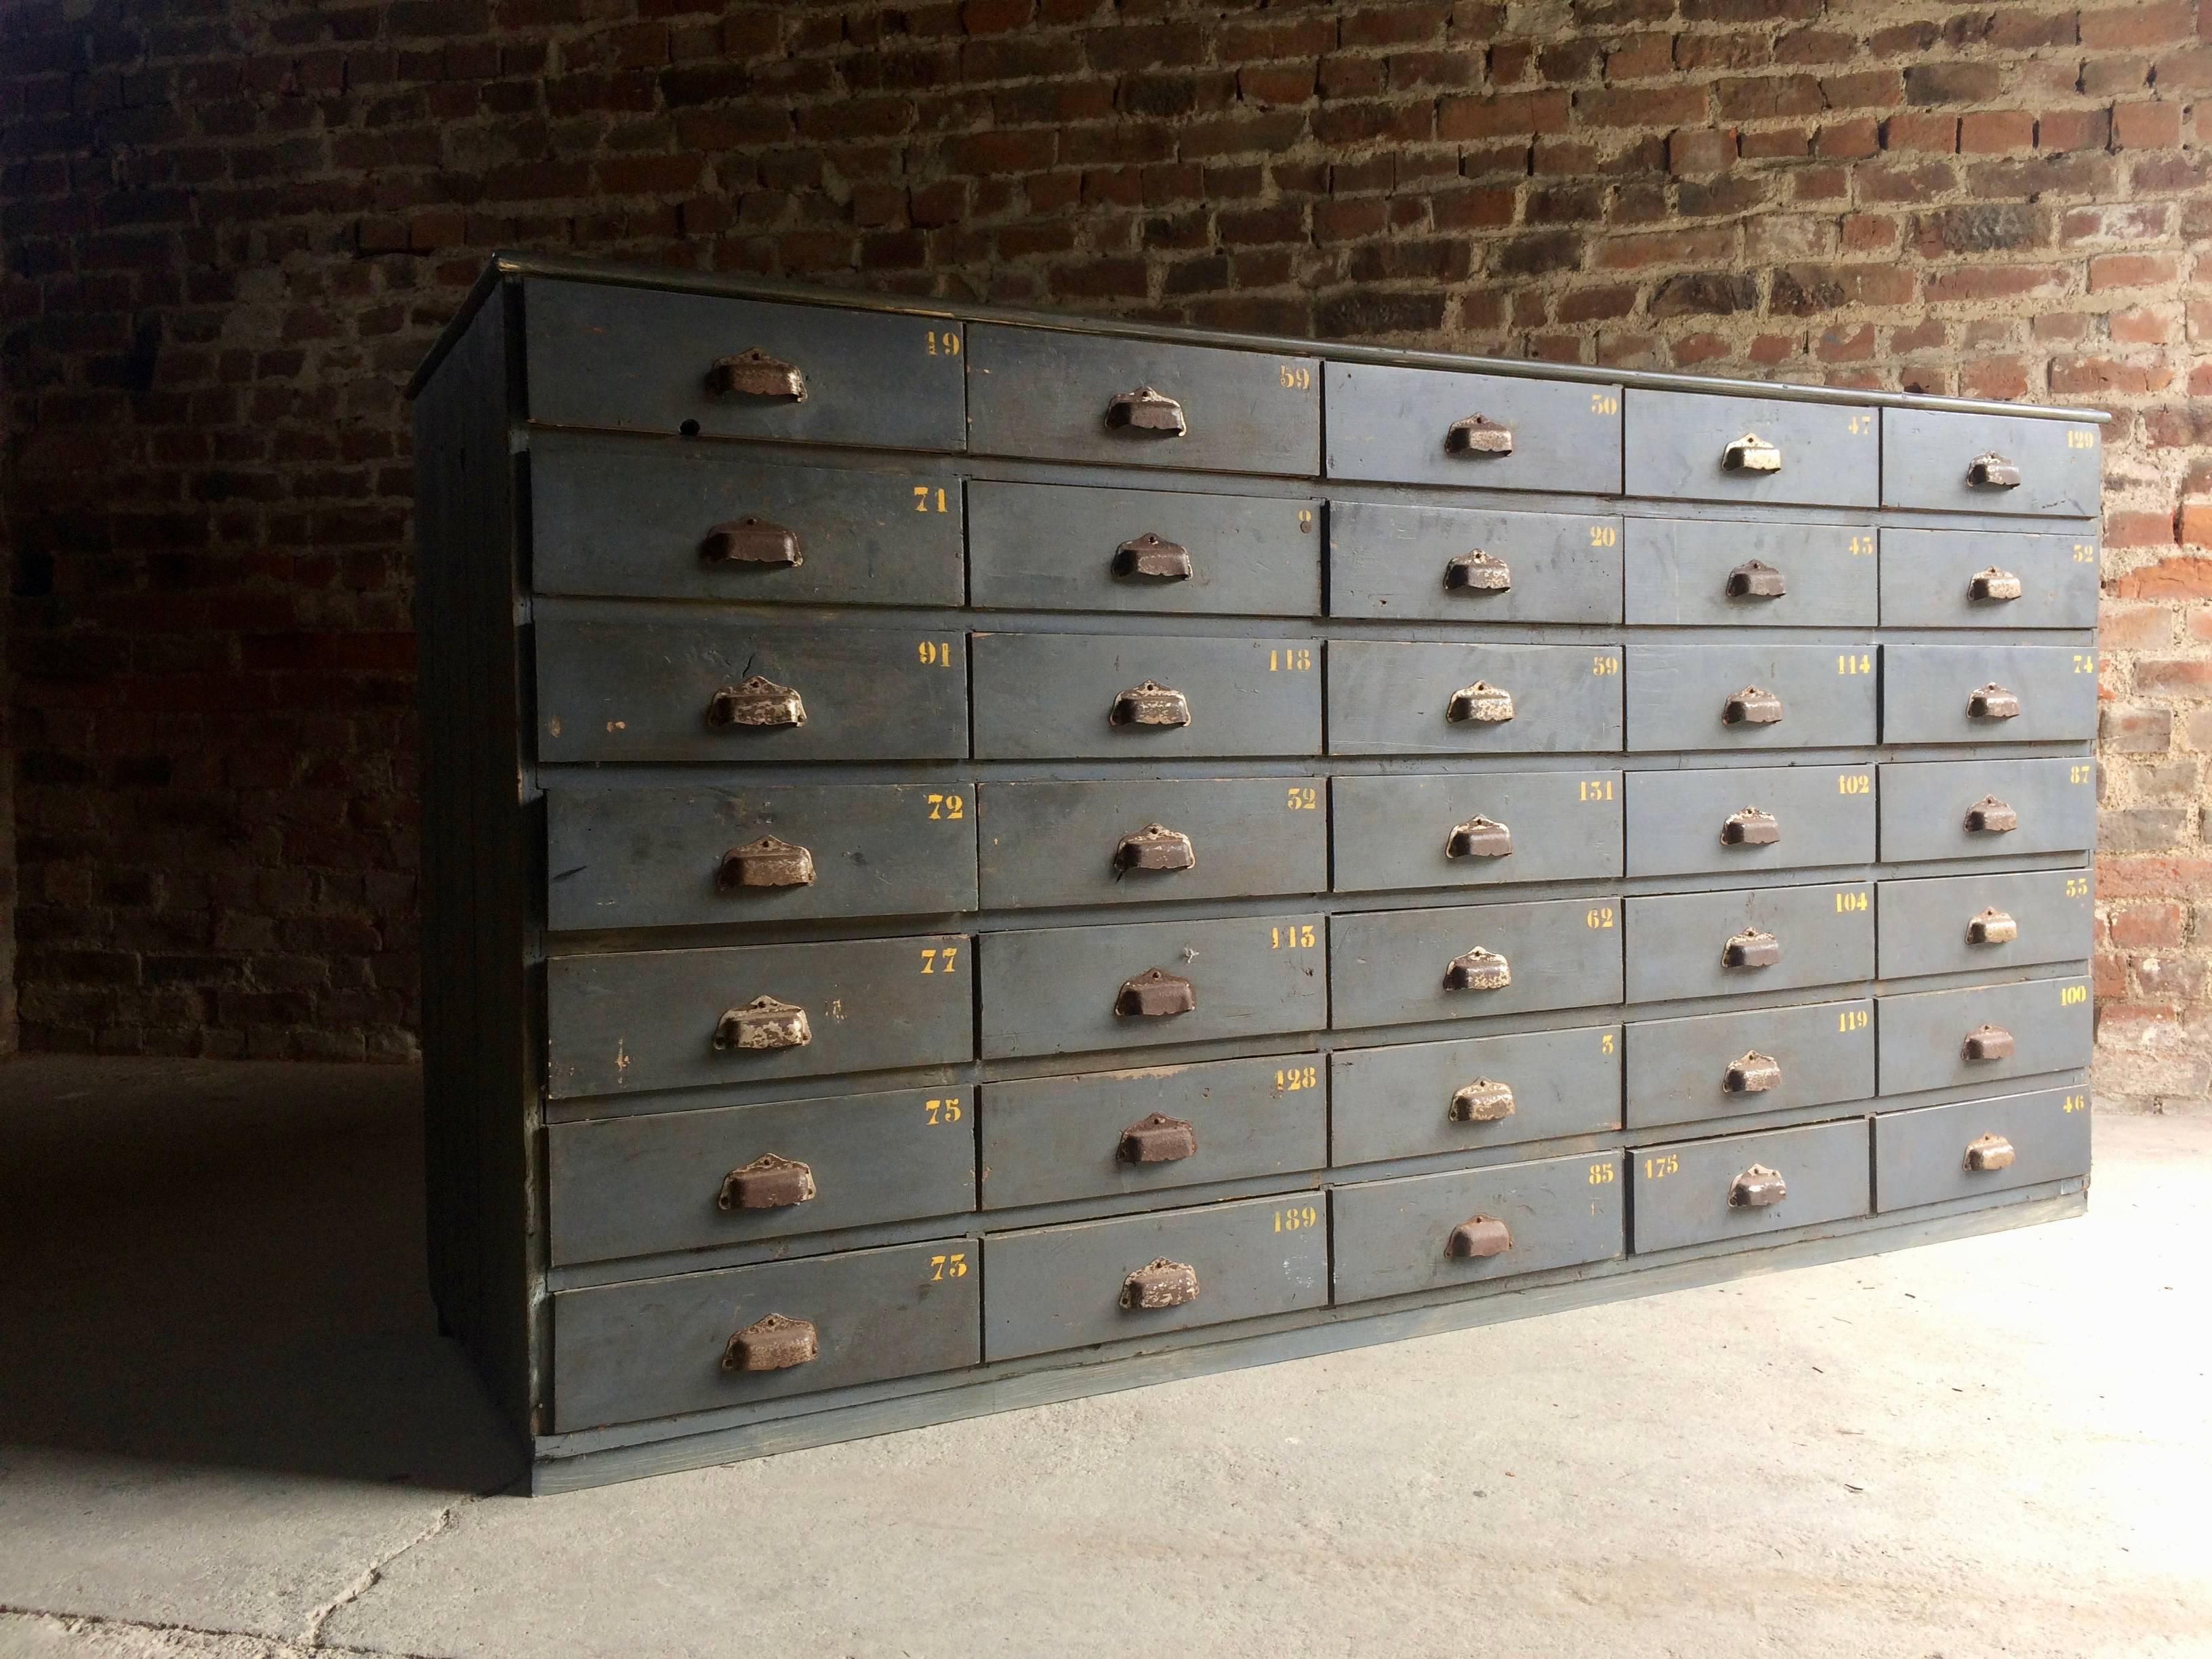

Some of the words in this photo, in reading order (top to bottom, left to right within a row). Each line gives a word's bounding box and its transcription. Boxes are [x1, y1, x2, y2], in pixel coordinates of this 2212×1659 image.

[927, 331, 959, 356] 19
[1280, 365, 1310, 390] 59
[1848, 417, 1870, 434] 47
[2068, 430, 2093, 449] 129
[914, 487, 947, 512] 71
[1590, 526, 1616, 547] 20
[918, 641, 951, 667] 91
[1269, 649, 1311, 672] 118
[1837, 655, 1870, 674] 114
[2073, 655, 2093, 674] 74
[1593, 656, 1618, 676] 59
[1839, 775, 1869, 794] 102
[2070, 765, 2090, 783] 87
[928, 794, 963, 819] 72
[1836, 893, 1867, 912] 104
[1587, 907, 1613, 928] 62
[921, 948, 957, 973] 77
[2060, 986, 2086, 1006] 100
[1838, 1010, 1868, 1032] 119
[1275, 1067, 1316, 1090] 128
[926, 1099, 961, 1125] 75
[2063, 1095, 2085, 1113] 46
[1589, 1163, 1614, 1185] 85
[1645, 1154, 1679, 1179] 175
[1274, 1206, 1316, 1232] 189
